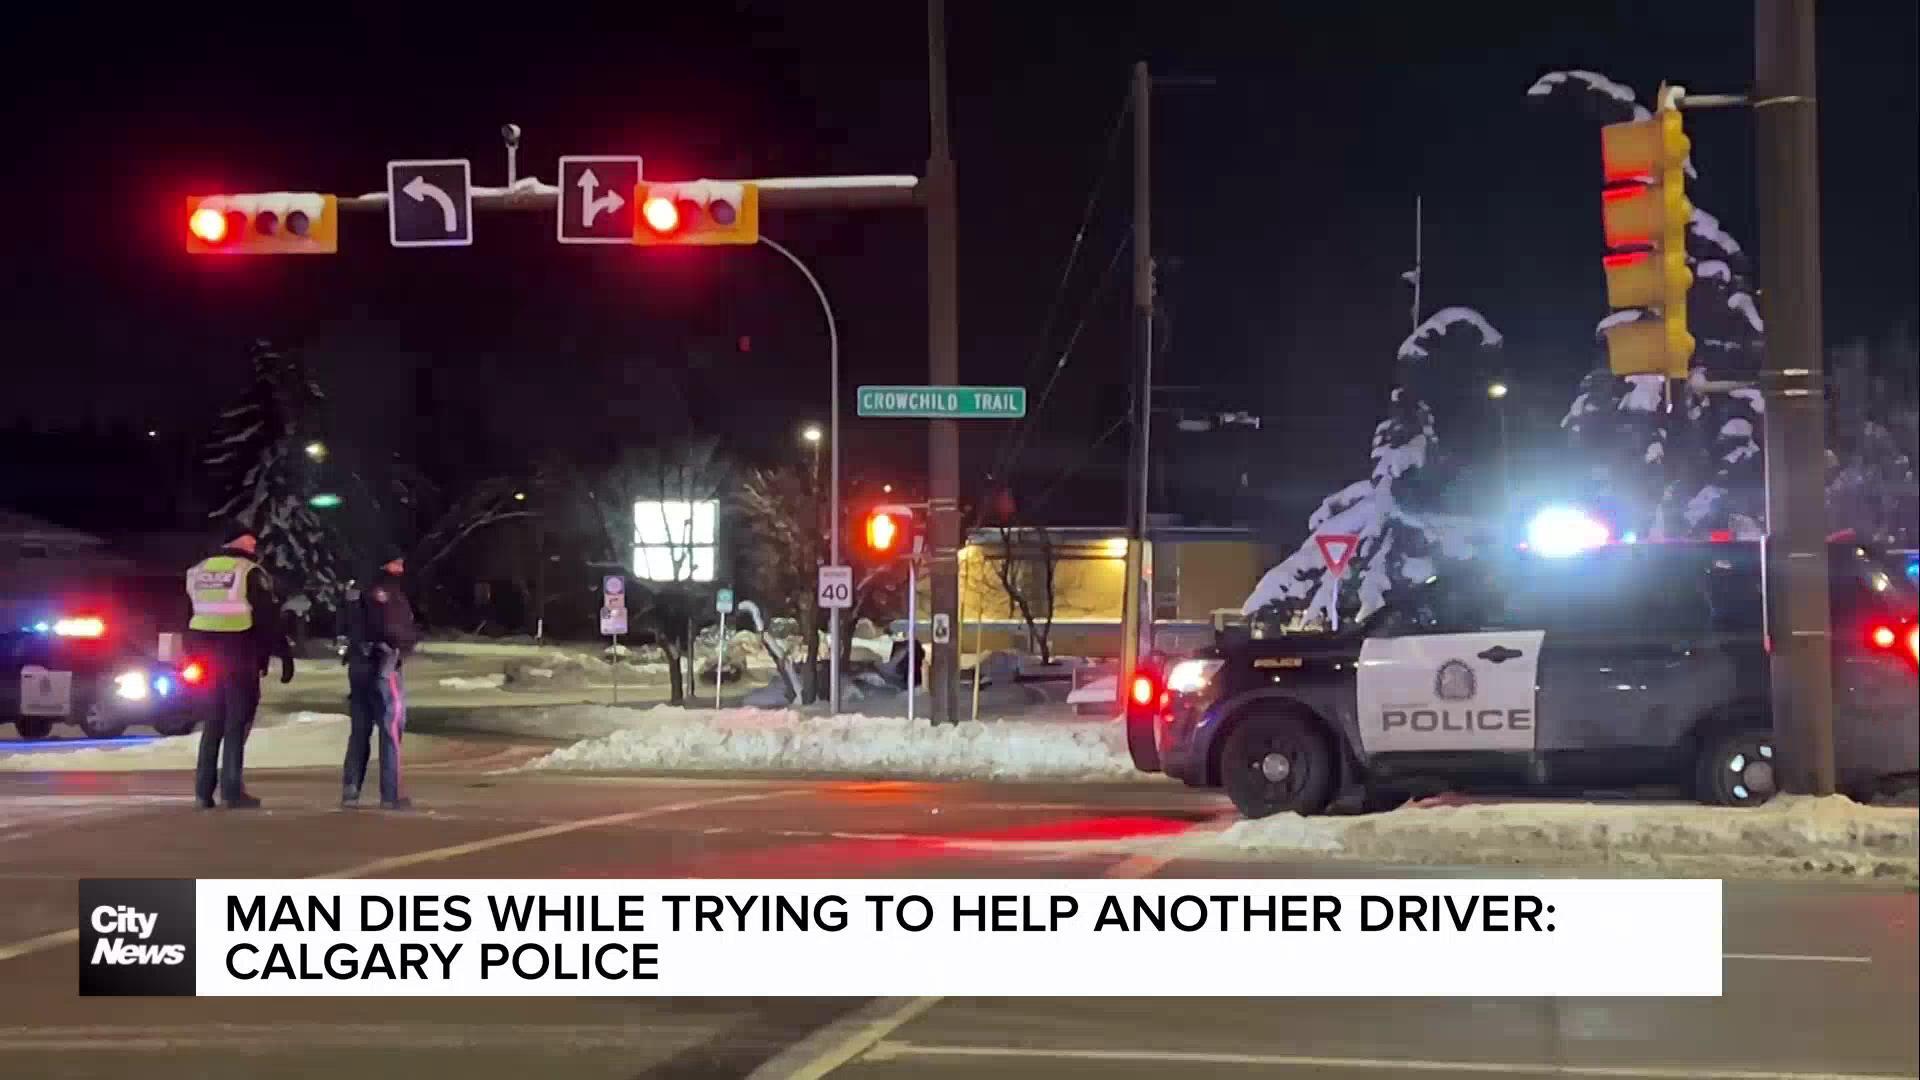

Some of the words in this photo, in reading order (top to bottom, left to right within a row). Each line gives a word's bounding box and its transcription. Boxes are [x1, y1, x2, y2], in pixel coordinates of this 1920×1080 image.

[863, 393, 958, 411] CROWCHILD
[973, 393, 1017, 411] TRAIL
[822, 583, 849, 600] 40
[1382, 709, 1531, 732] POLICE
